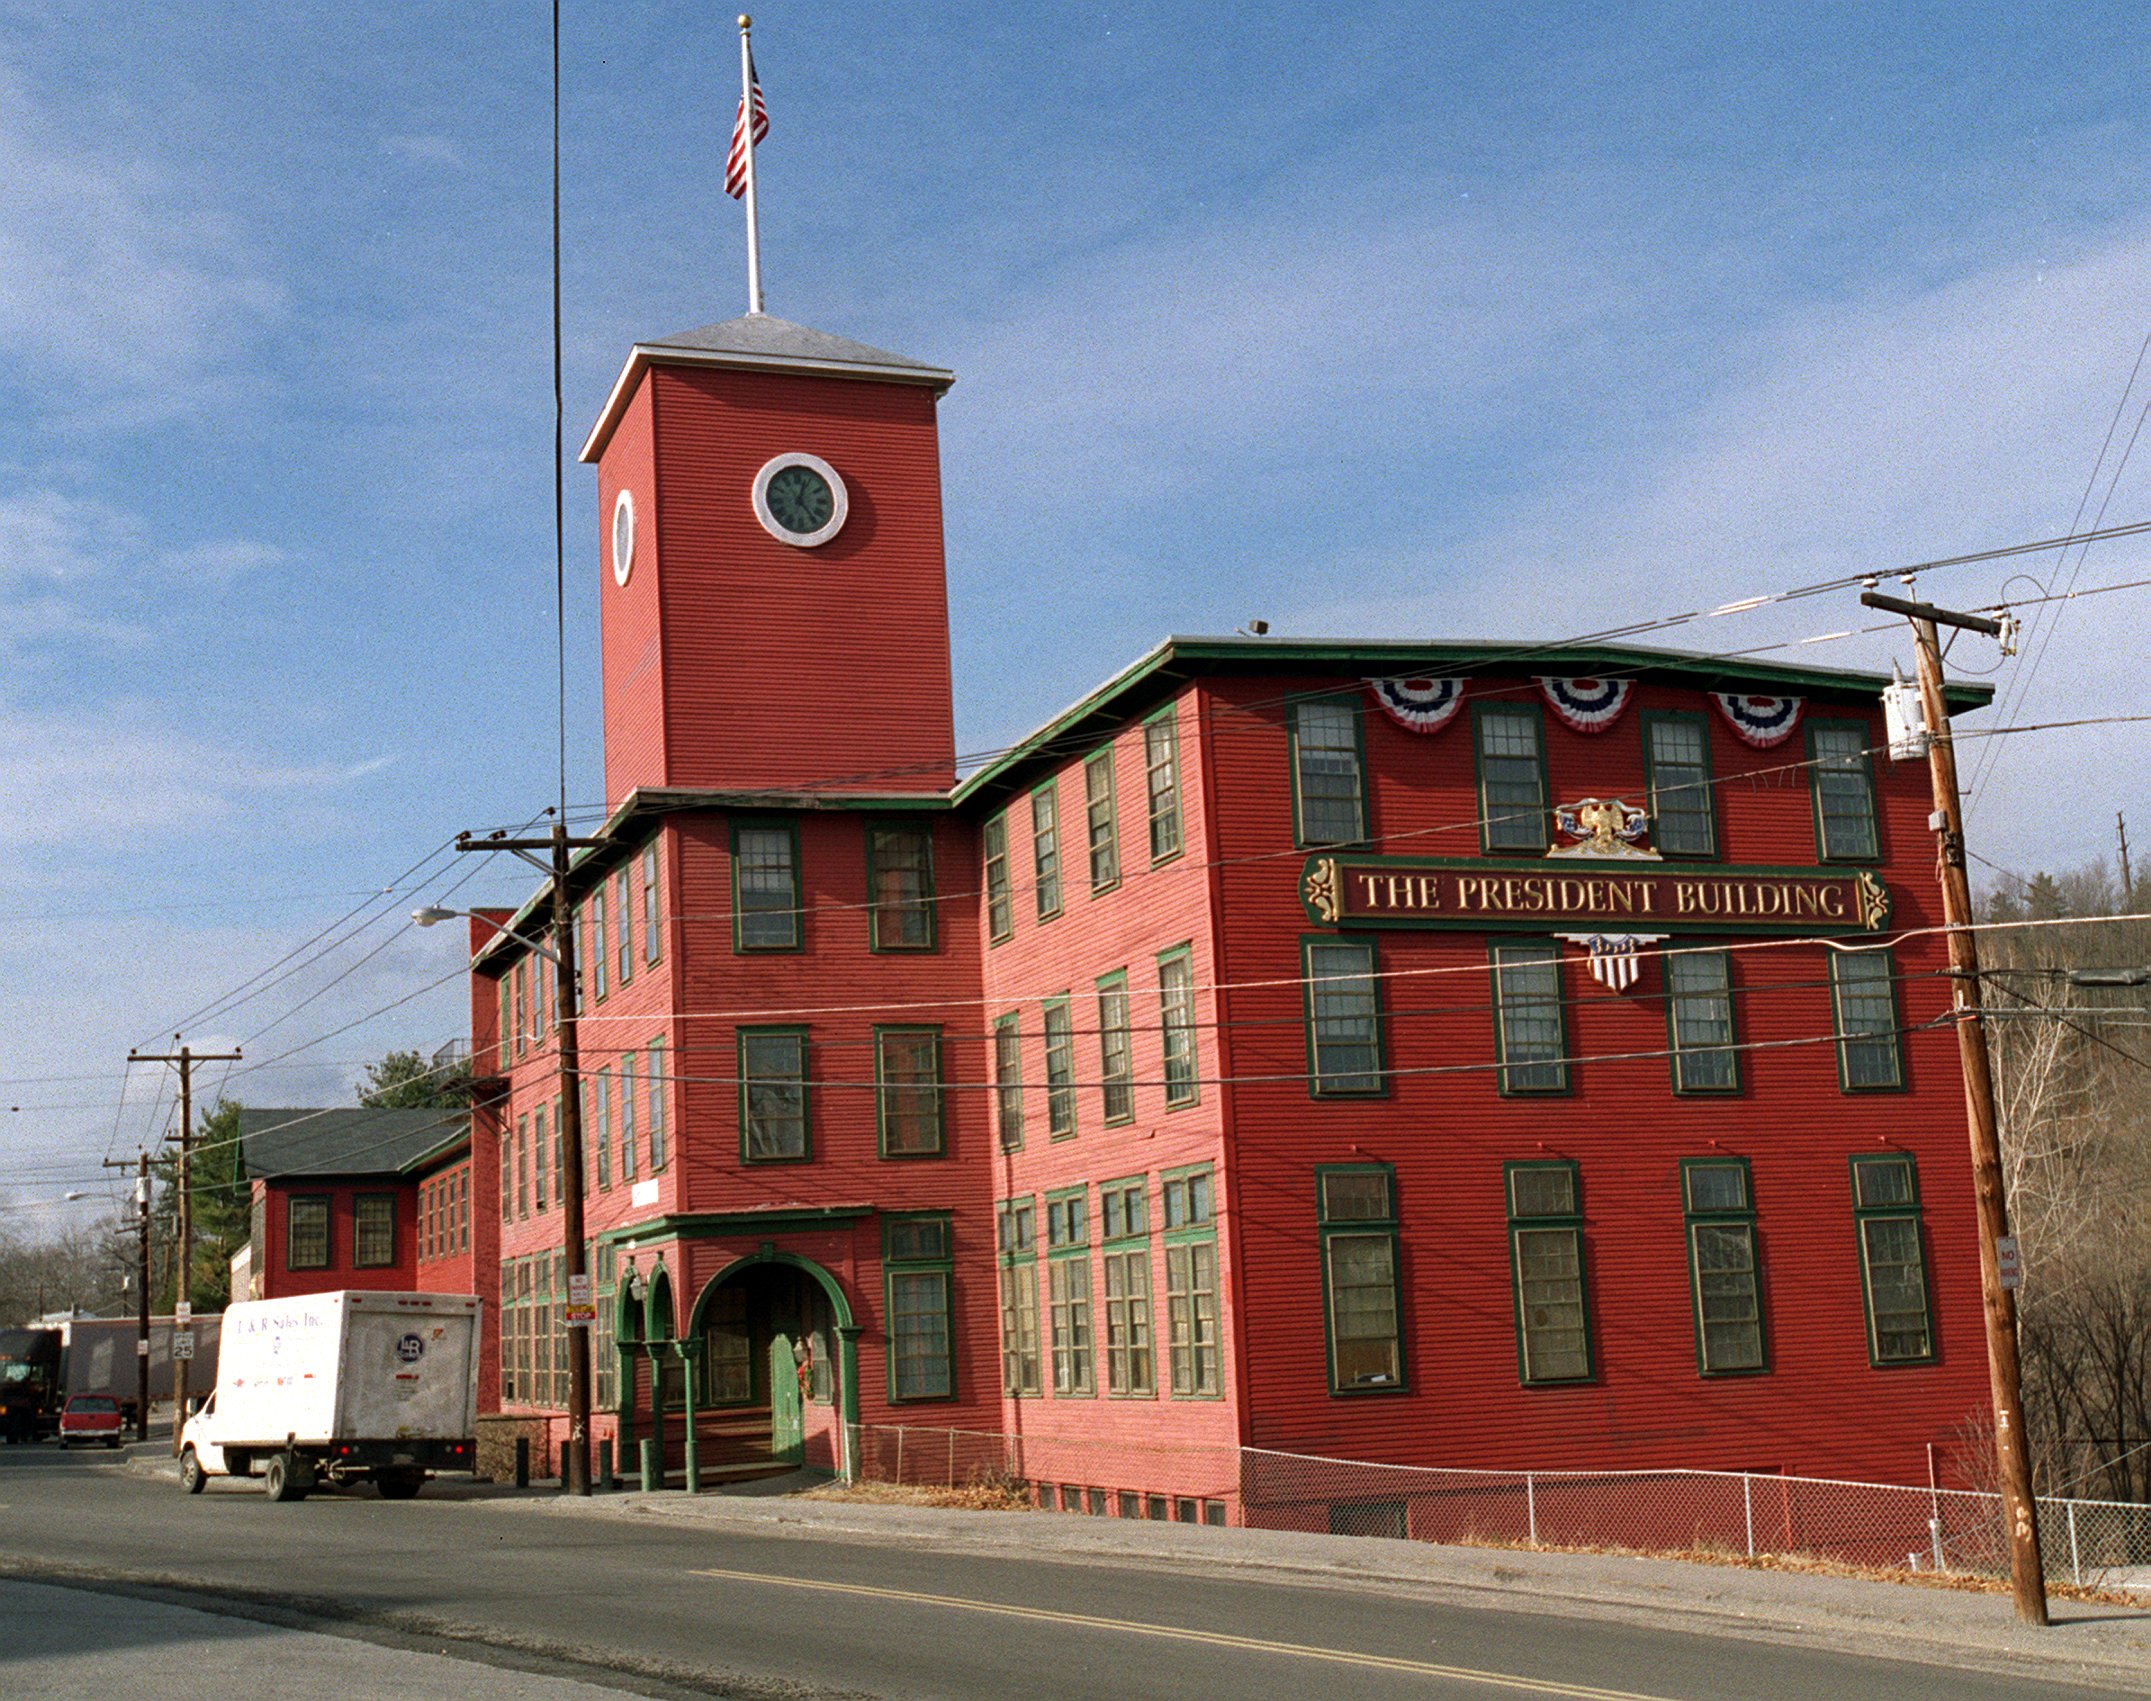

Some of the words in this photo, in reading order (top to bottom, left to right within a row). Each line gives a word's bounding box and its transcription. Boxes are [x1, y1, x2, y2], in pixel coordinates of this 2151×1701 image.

[1359, 874, 1440, 908] THE
[1456, 876, 1657, 913] PRESIDENT
[1674, 881, 1844, 917] BUILDING
[174, 1345, 193, 1357] 25
